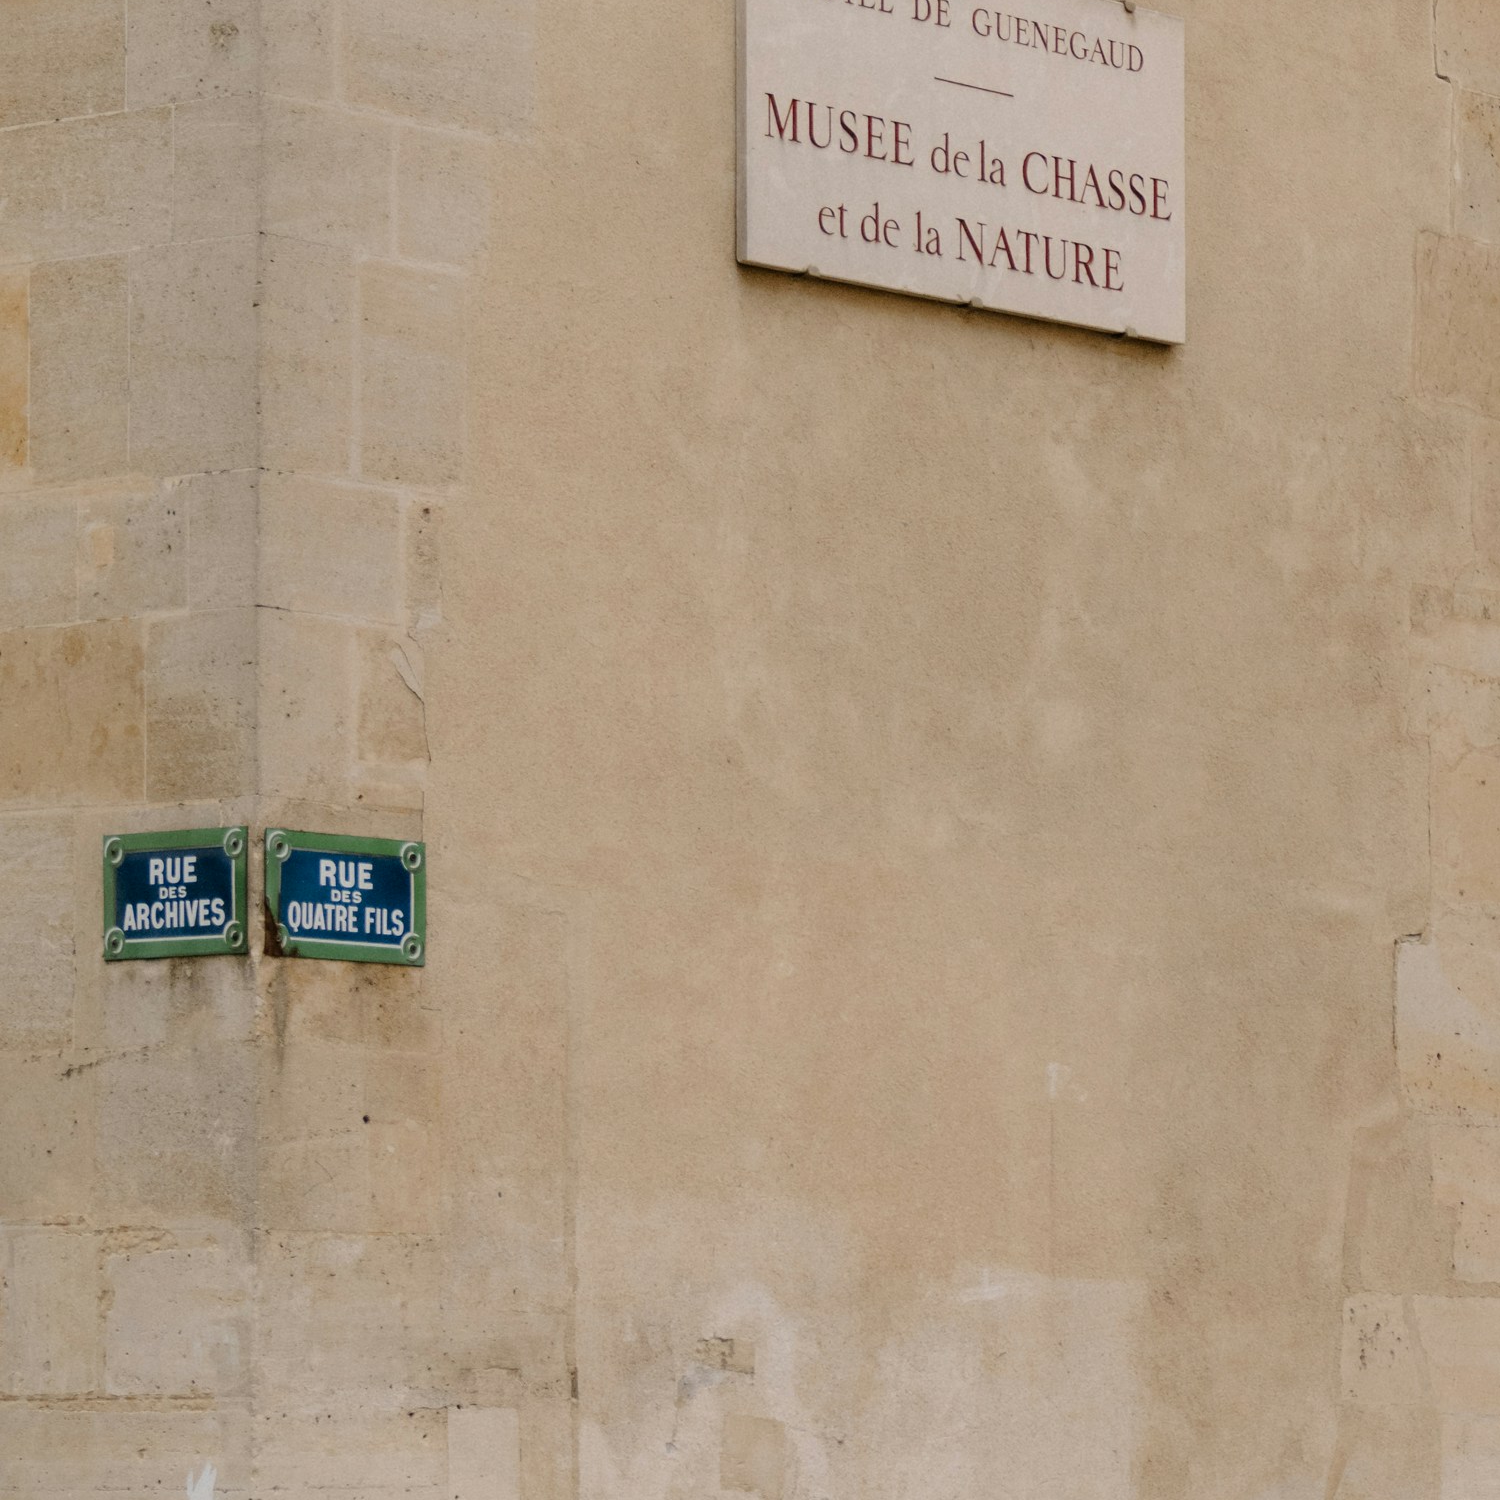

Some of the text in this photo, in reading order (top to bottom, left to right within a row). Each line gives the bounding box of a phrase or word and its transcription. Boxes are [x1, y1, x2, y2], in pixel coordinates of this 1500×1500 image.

[972, 7, 1144, 73] GUENEGAUD
[764, 92, 1173, 222] MUSEE de la CHASSE
[818, 201, 1125, 293] et de la NATURE
[149, 855, 198, 886] RUE
[319, 859, 374, 891] RUE
[158, 885, 187, 900] DES
[330, 890, 362, 904] DES
[123, 898, 226, 932] ARCHIVES
[287, 901, 405, 938] QUATRE FILS
